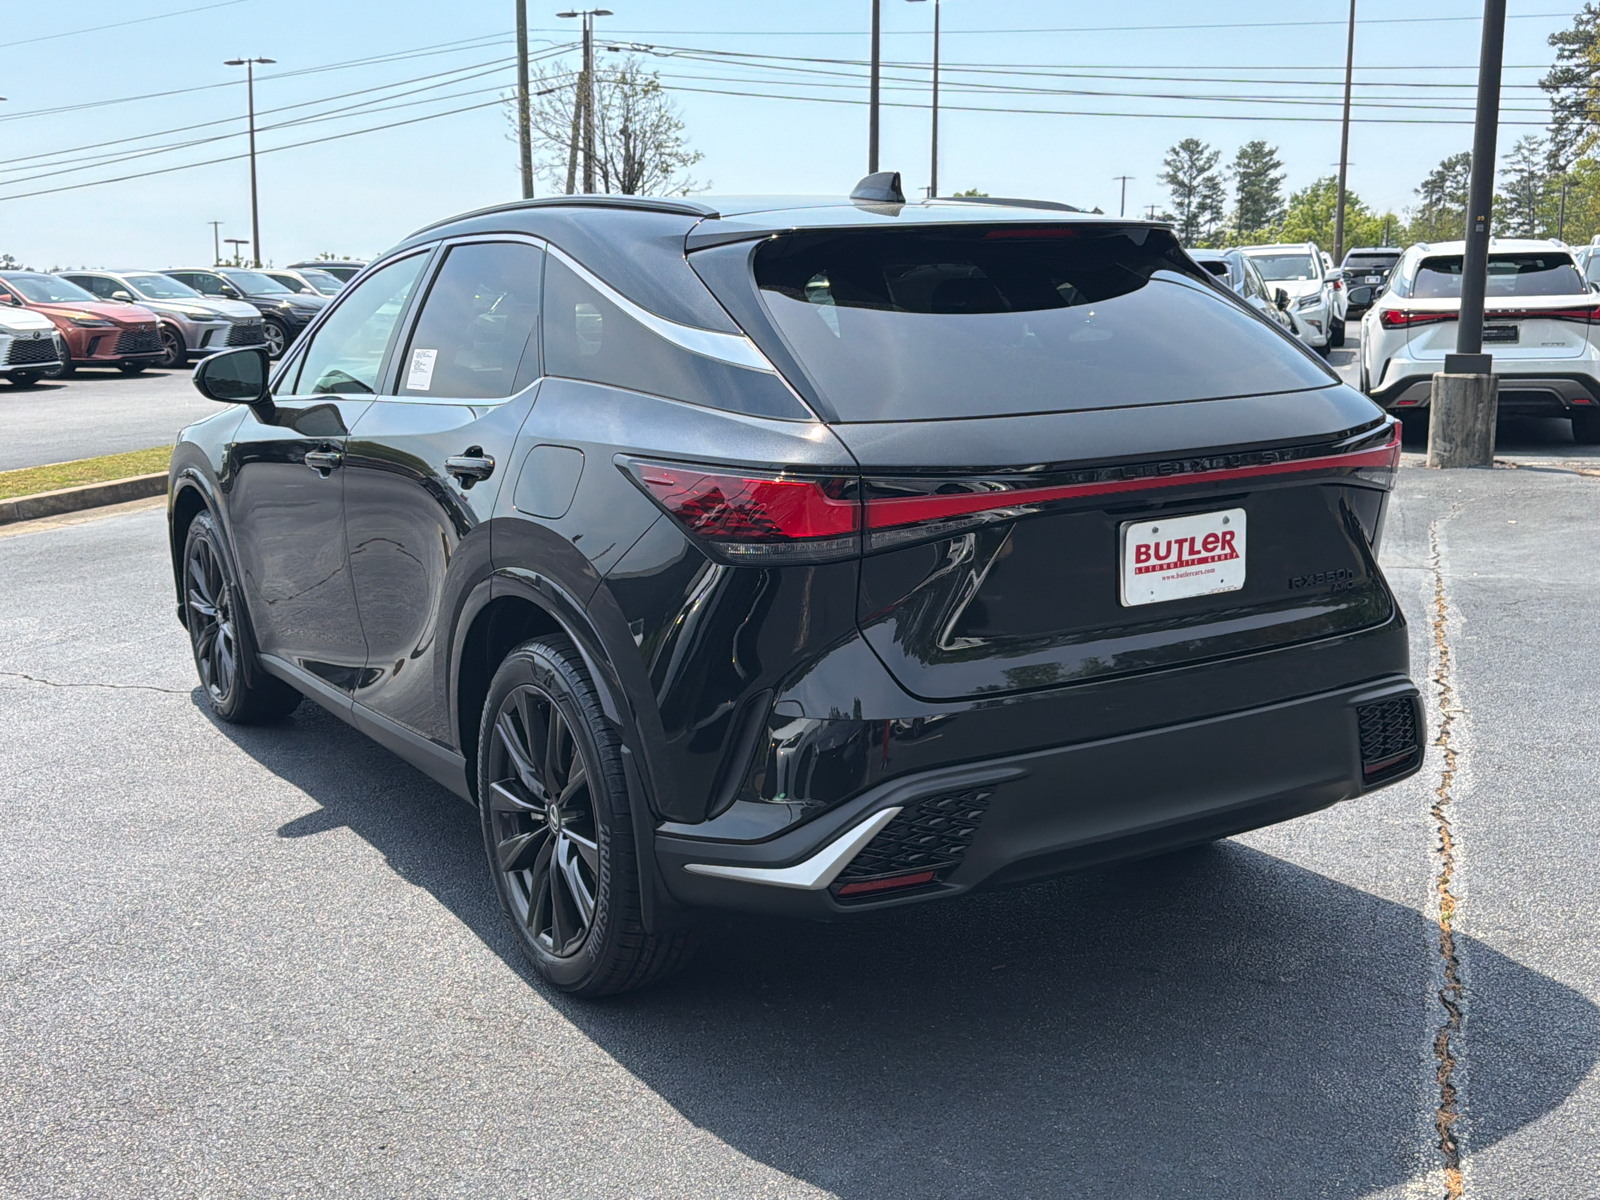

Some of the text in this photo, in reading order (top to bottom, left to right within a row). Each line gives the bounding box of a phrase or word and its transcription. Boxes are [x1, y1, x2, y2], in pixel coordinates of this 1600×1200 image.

[1121, 450, 1275, 478] LEXUS
[1135, 552, 1238, 574] AUTOMOTIVE GROUP
[1162, 567, 1216, 581] www.butlercars.com
[588, 823, 612, 963] BRIDGESTONE
